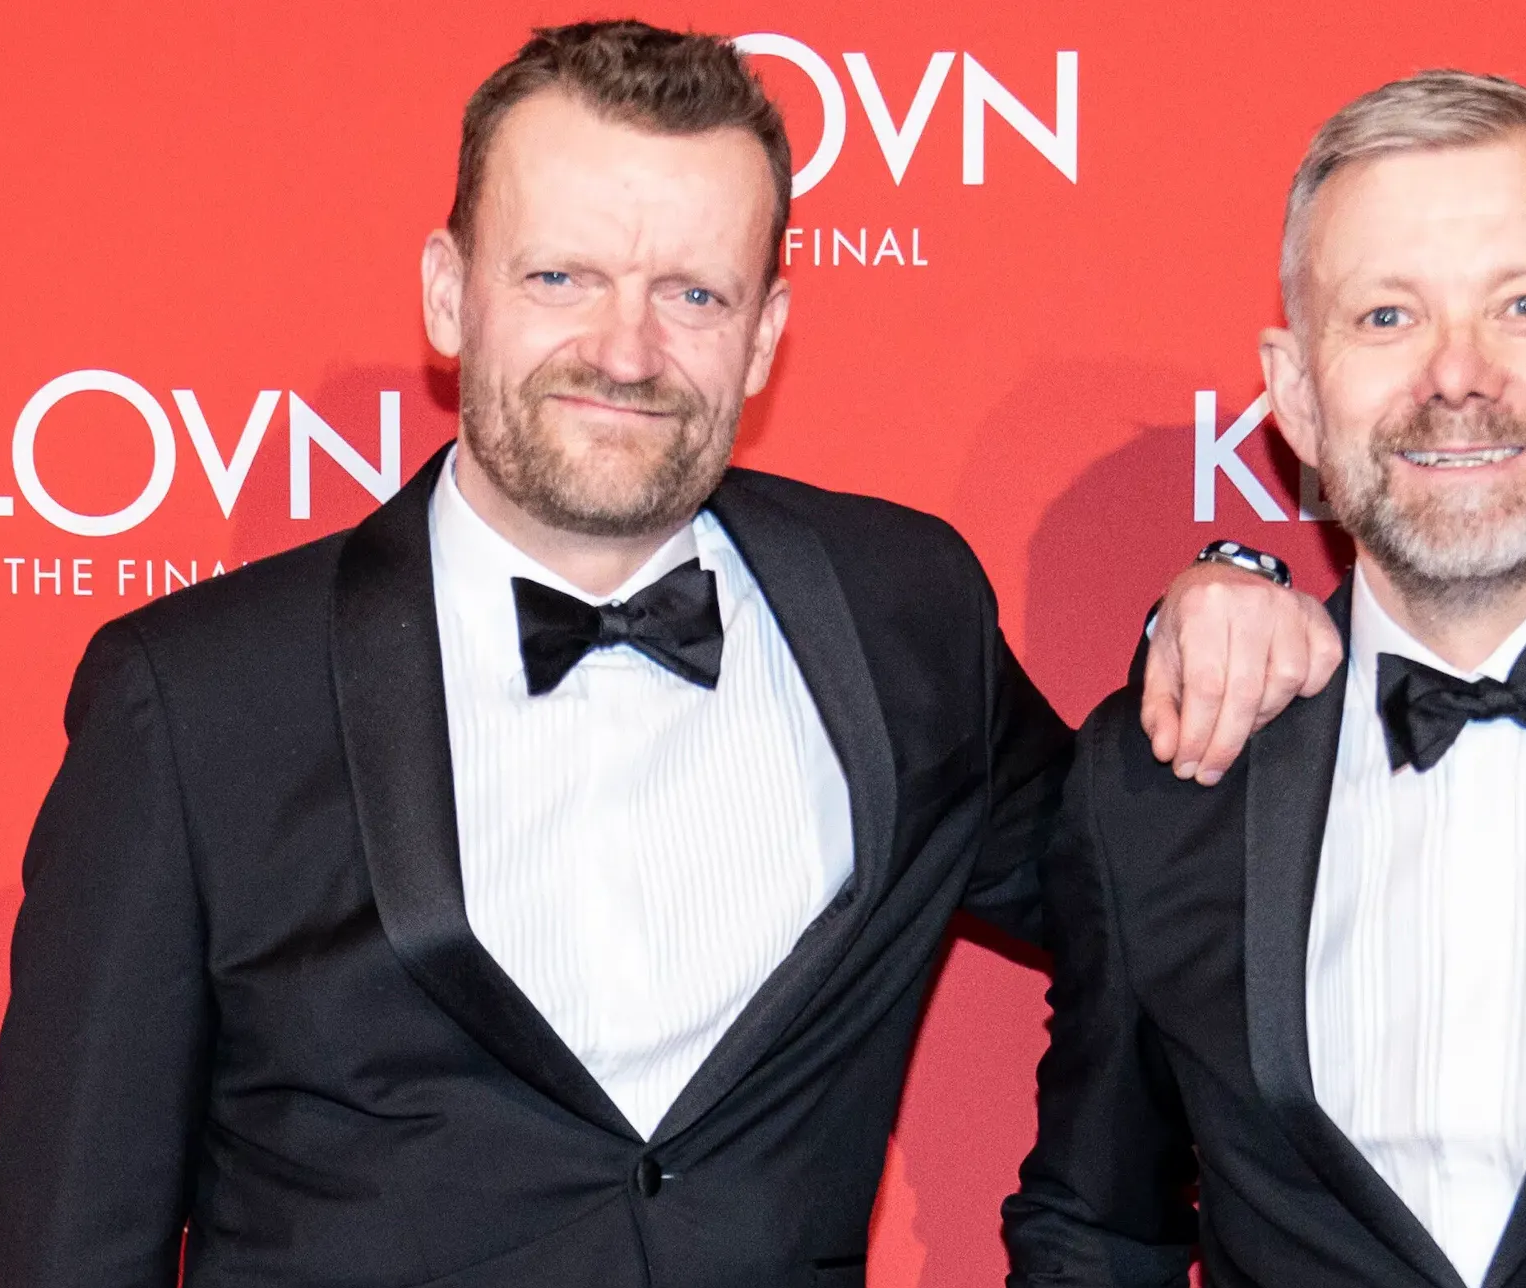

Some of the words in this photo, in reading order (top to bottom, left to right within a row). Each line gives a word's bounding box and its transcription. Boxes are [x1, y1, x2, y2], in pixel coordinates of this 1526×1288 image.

[726, 32, 1078, 200] OVN
[784, 227, 929, 267] FINAL
[3, 557, 94, 597] THE
[118, 558, 247, 598] FIN
